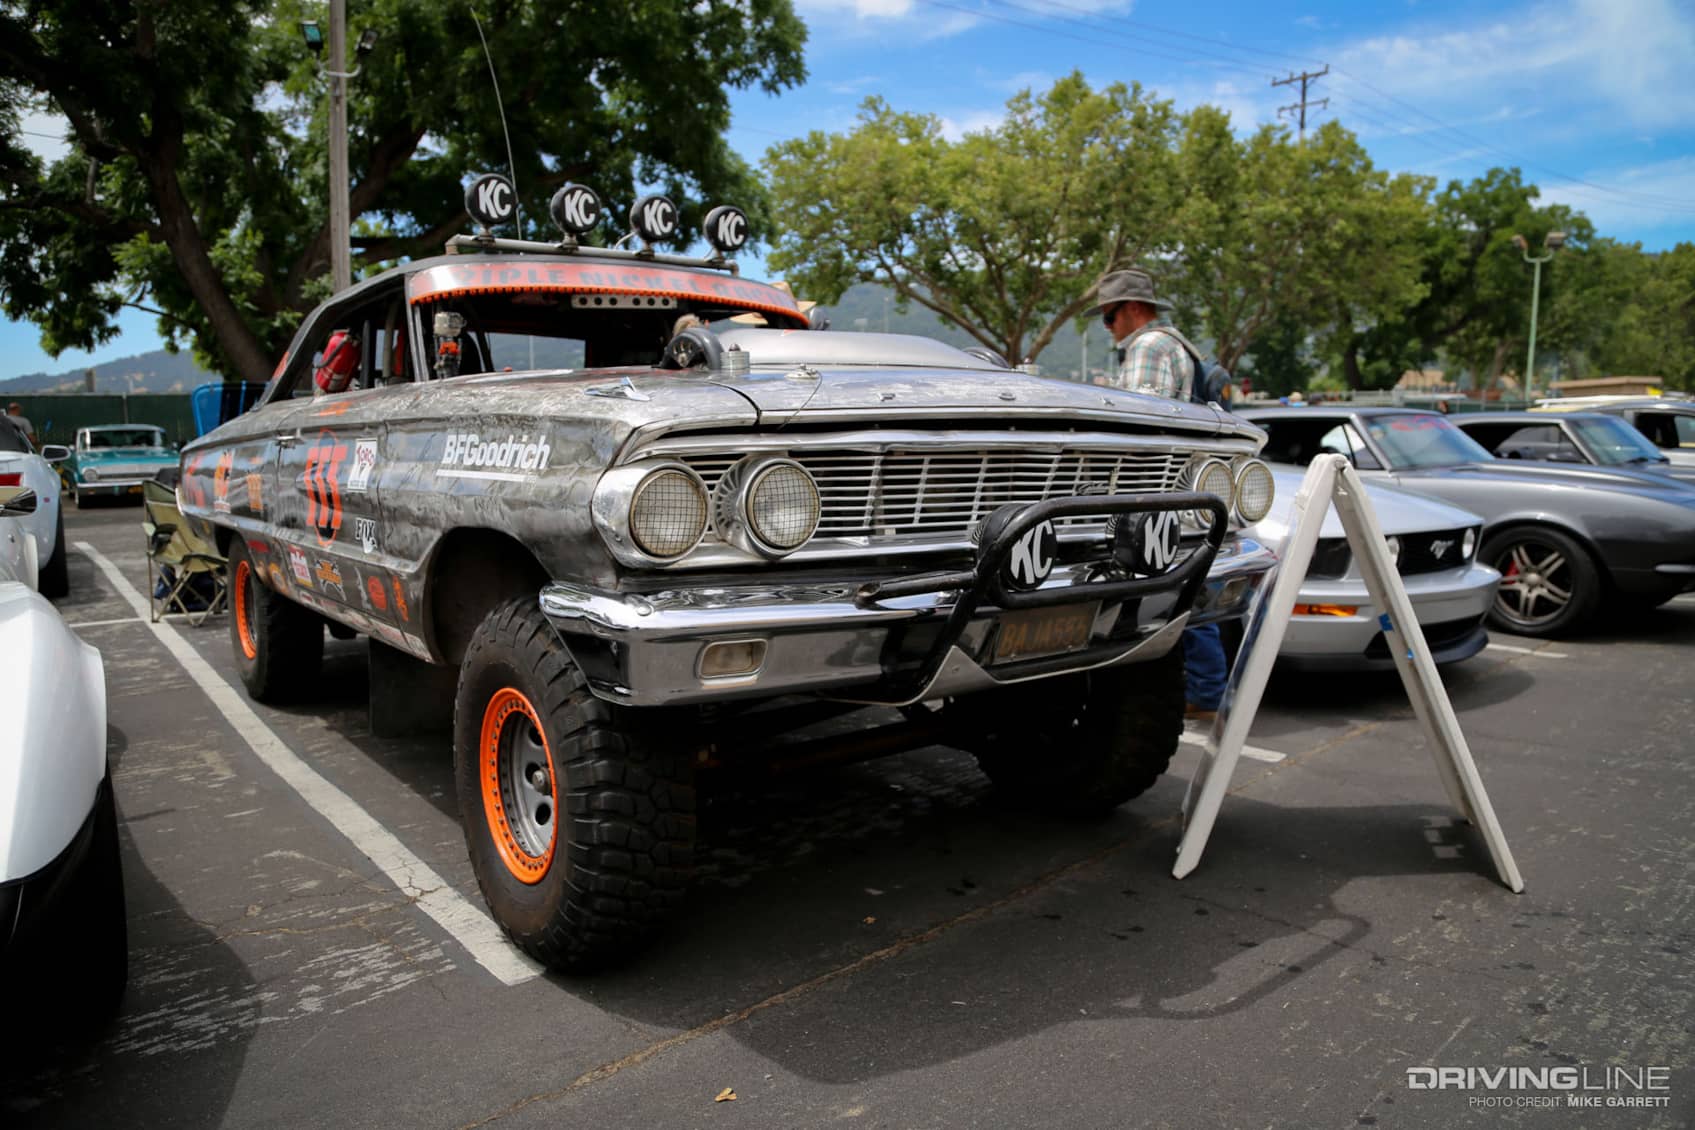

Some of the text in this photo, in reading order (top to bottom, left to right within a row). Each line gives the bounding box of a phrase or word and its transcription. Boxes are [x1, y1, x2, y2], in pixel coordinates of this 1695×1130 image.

[479, 180, 512, 218] KC
[564, 190, 595, 227] KC
[644, 200, 673, 236] KC
[718, 212, 745, 247] KC
[436, 267, 566, 286] RIPLE
[441, 434, 550, 470] BFGoodrich
[1010, 519, 1052, 584] KC
[1144, 511, 1178, 569] KC
